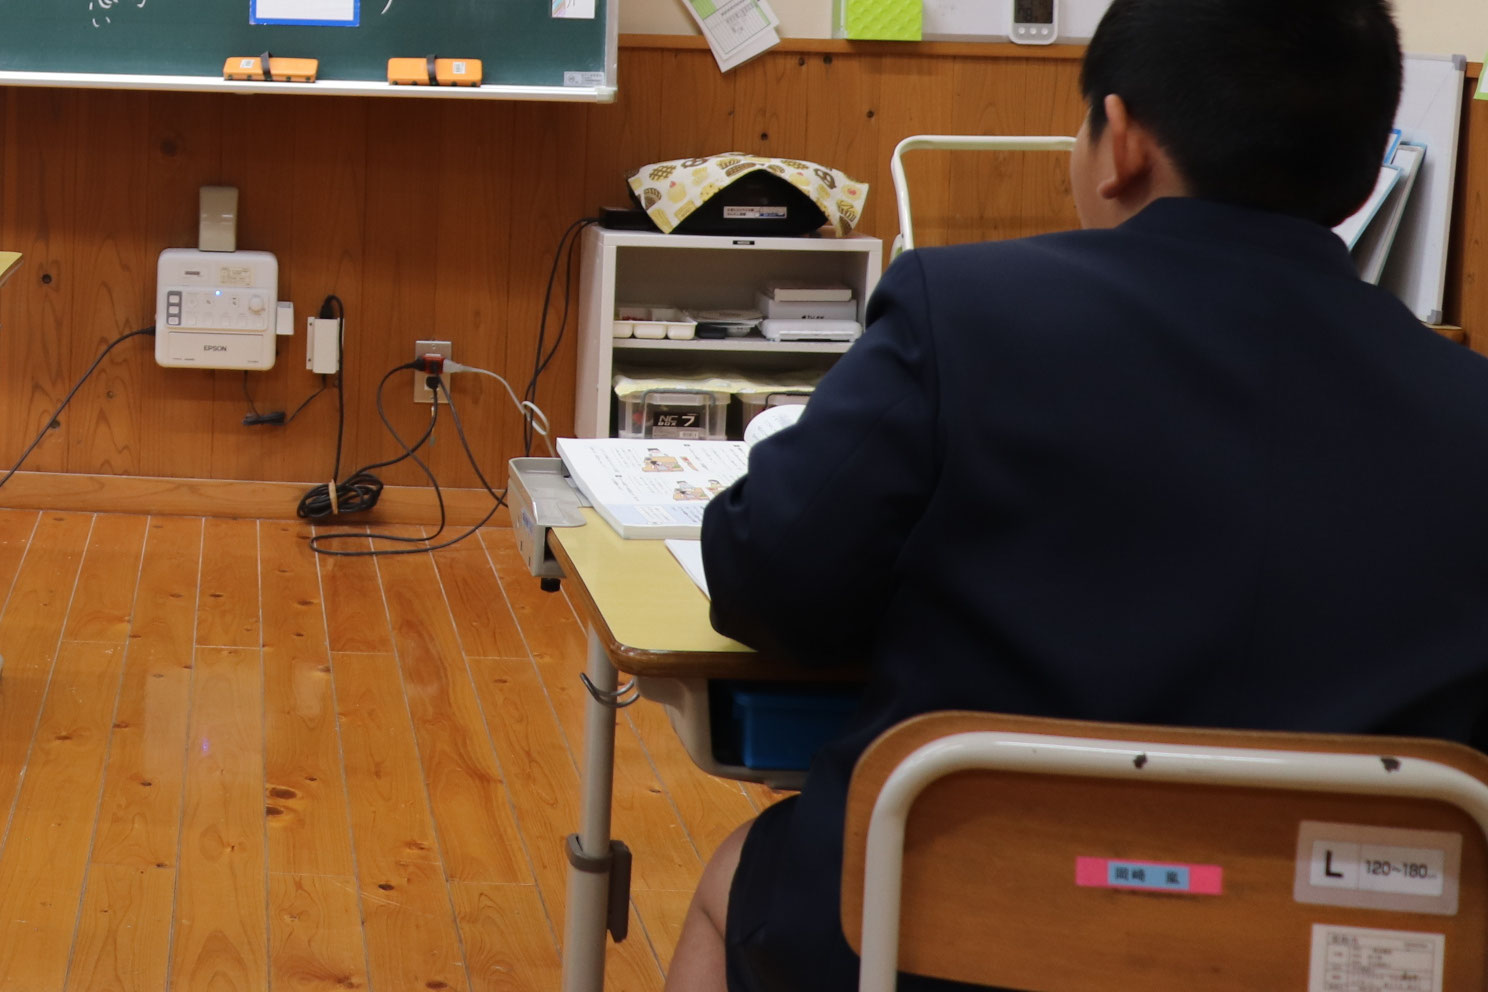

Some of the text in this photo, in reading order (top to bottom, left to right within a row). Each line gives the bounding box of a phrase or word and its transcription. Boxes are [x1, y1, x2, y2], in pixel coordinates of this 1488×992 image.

[203, 344, 228, 352] EPSON
[681, 415, 696, 427] 7
[1325, 850, 1344, 878] L
